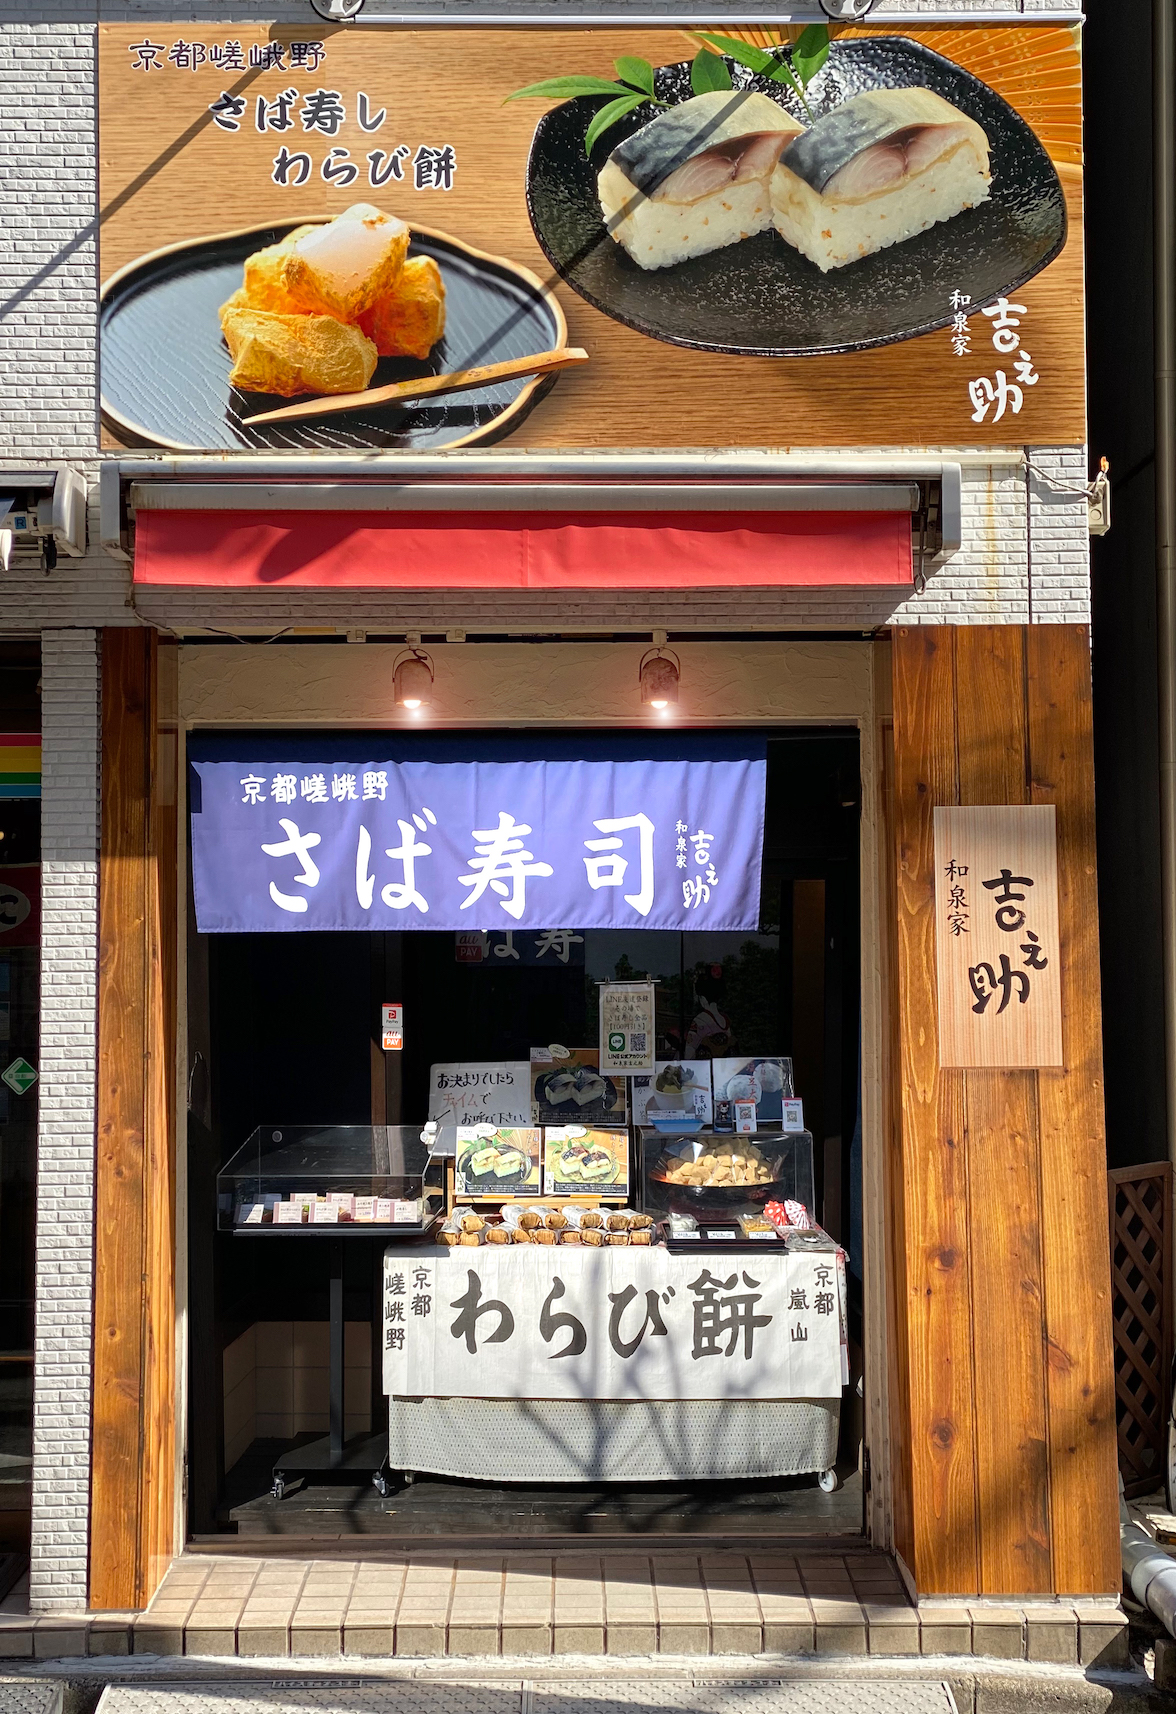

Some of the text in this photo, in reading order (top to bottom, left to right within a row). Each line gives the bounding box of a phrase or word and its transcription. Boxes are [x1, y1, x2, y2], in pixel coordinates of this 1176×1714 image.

[128, 40, 327, 71] 京都嵯峨野
[209, 90, 388, 133] さば寿し
[271, 144, 456, 190] わらび餅
[948, 288, 972, 356] 和泉家
[239, 770, 388, 805] 京都嵯峨野
[260, 806, 656, 920] さば寿司
[675, 819, 688, 869] 和泉家
[944, 859, 970, 936] 和泉家
[460, 947, 478, 957] PAY
[443, 1092, 492, 1108] チャイムで
[384, 1272, 407, 1350] 嵯峨野
[411, 1266, 432, 1318] 京都
[449, 1268, 773, 1361] わらび餅
[787, 1288, 809, 1342] 嵐山
[813, 1263, 835, 1316] 京都
